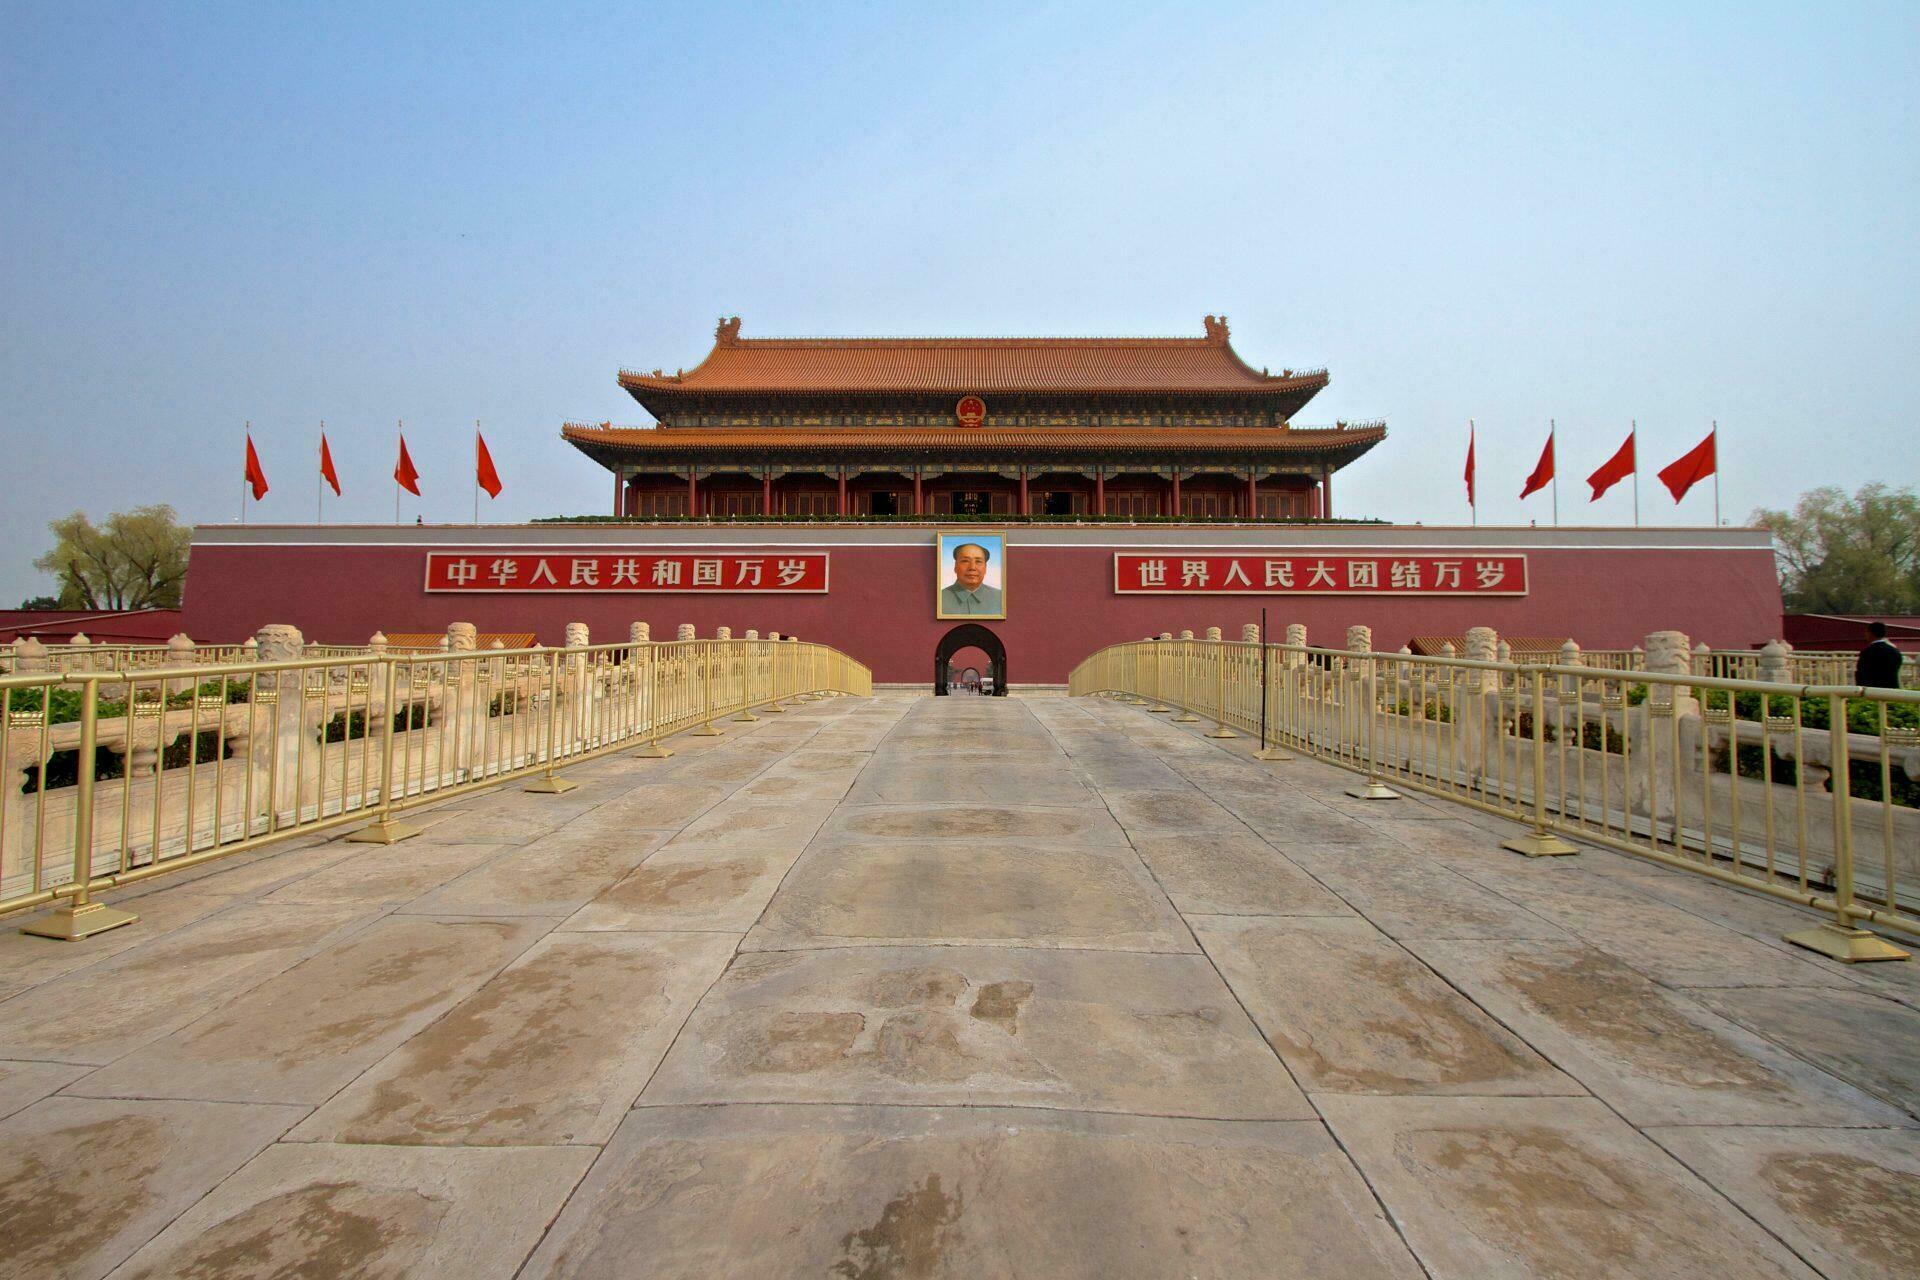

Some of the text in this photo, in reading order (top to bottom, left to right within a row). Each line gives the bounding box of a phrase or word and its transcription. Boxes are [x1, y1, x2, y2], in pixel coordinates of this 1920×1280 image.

[446, 559, 806, 586] 中华人民共和国万岁
[1138, 560, 1506, 588] 世界人民大团结万岁
